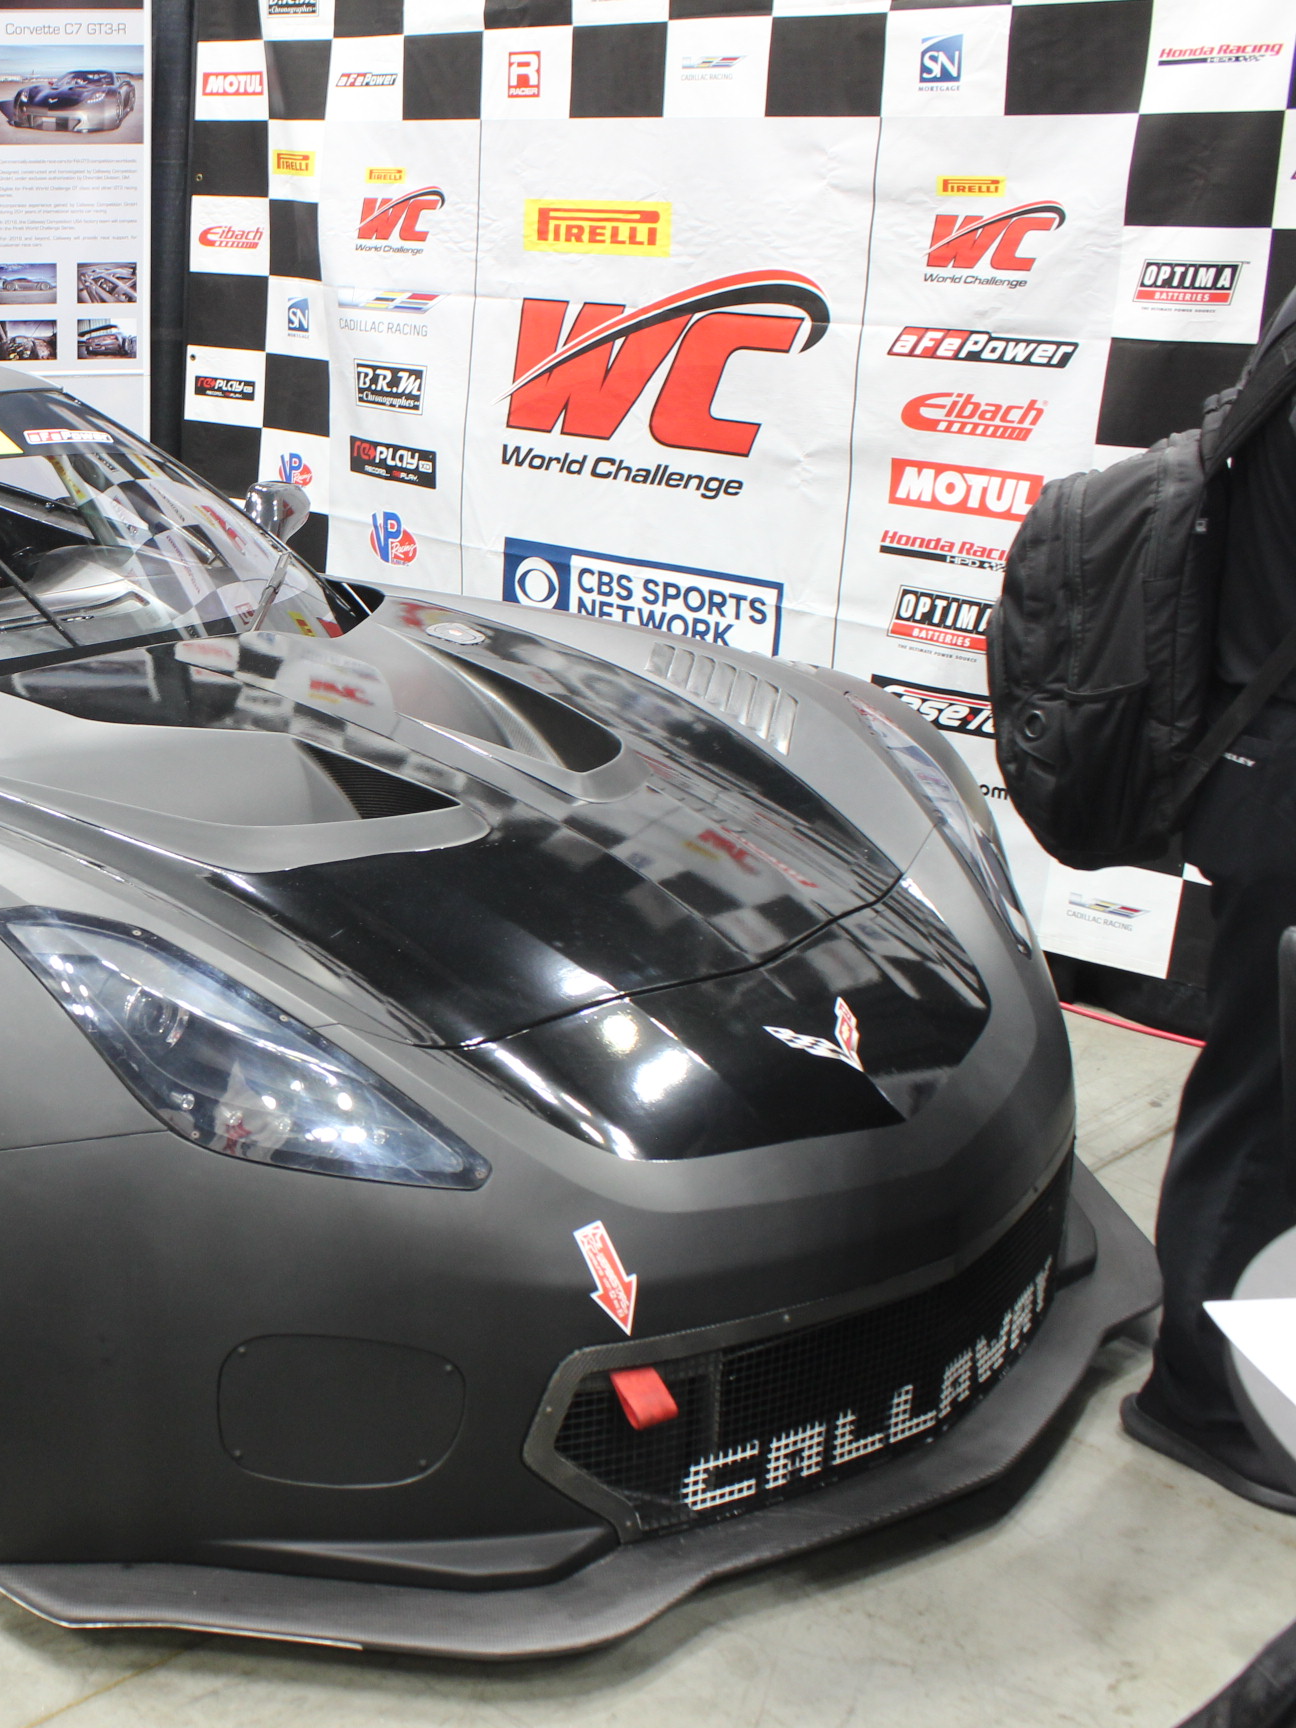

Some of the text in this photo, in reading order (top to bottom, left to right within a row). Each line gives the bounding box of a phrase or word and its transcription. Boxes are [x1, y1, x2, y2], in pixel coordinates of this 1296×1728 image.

[5, 23, 127, 35] Corvette C7 GT3-R
[1159, 43, 1284, 59] Honda Racing
[508, 54, 540, 86] R
[922, 50, 960, 79] SN
[205, 75, 263, 93] MOTUL
[508, 87, 539, 96] RACER
[276, 153, 310, 171] PIRELLI
[368, 169, 403, 181] PIRELLI
[942, 178, 1000, 193] PIRELLI
[357, 197, 440, 242] WC
[537, 207, 661, 246] PIRELLI
[198, 226, 263, 249] Eibach
[926, 214, 1057, 272] WC
[354, 243, 424, 256] World Challenge
[923, 272, 1028, 290] World Challenge
[1142, 264, 1233, 289] OPTIMA
[1154, 291, 1210, 302] BATTERIES
[287, 308, 309, 332] SN
[339, 317, 428, 337] CADILLAC RACING
[505, 297, 806, 458] WC
[362, 390, 416, 408] Chronographes
[900, 391, 1046, 442] Eibach
[501, 443, 744, 500] World Challenge
[895, 466, 1037, 516] MOTUL
[371, 511, 403, 563] VP
[880, 529, 1008, 562] Honda Raci
[391, 541, 419, 558] Racing
[946, 555, 980, 568] HPD
[577, 567, 768, 626] CBS SPORTS
[911, 628, 971, 648] BATTERIES
[908, 645, 933, 656] ULTIMATE
[934, 651, 954, 660] POWER
[955, 655, 979, 664] SOURCE
[1065, 909, 1134, 933] CADILLAC RACING
[682, 1254, 1054, 1512] CALLAWAY
